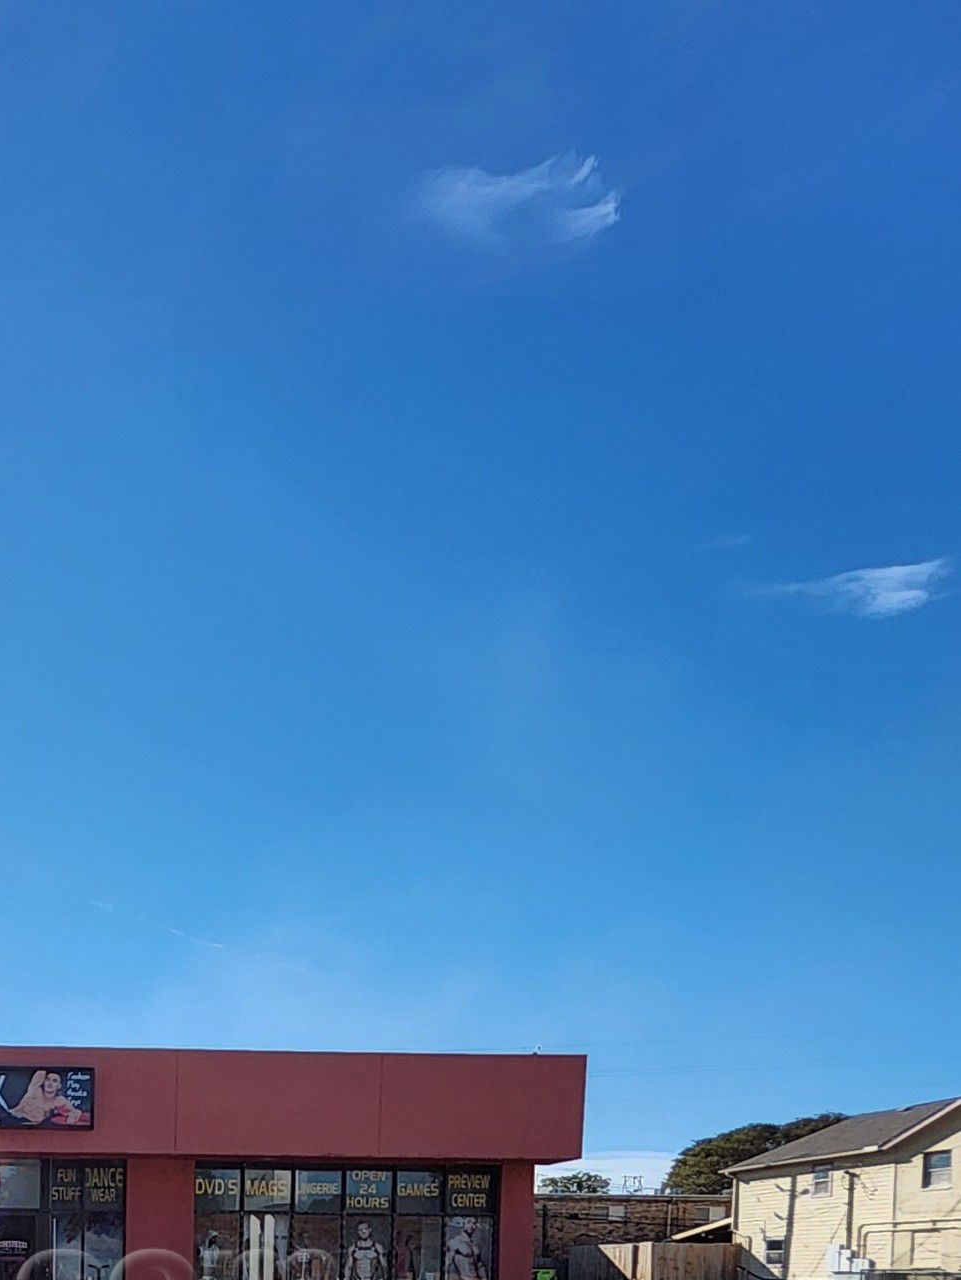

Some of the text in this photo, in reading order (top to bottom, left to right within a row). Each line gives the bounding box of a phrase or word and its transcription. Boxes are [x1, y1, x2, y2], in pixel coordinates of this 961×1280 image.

[58, 1168, 76, 1183] FUN
[351, 1170, 387, 1181] OPEN
[448, 1174, 490, 1189] PREVIEW
[51, 1187, 82, 1200] STUFF
[195, 1179, 237, 1195] DVD'S
[246, 1179, 288, 1196] MAGS
[359, 1183, 377, 1195] 24
[397, 1182, 439, 1196] GAMES
[91, 1188, 116, 1202] WEAR
[451, 1193, 487, 1207] CENTER
[346, 1196, 389, 1209] HOURS
